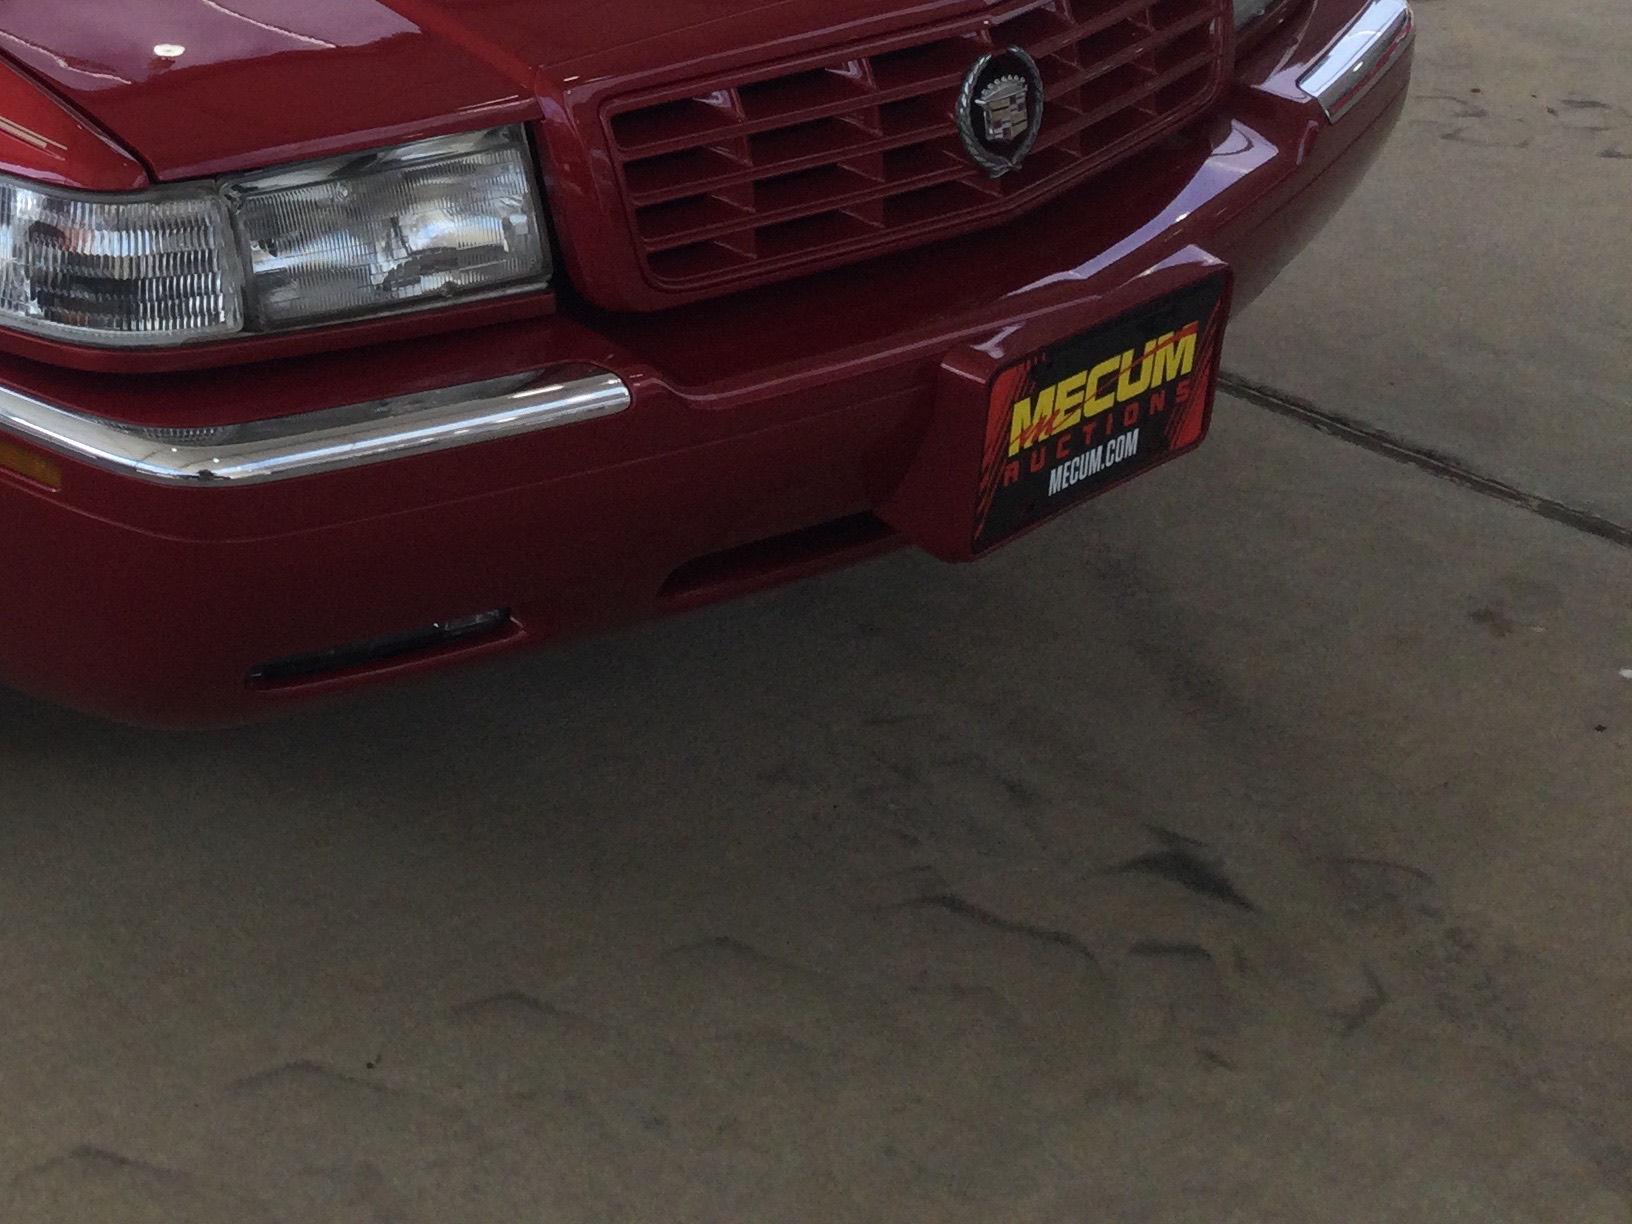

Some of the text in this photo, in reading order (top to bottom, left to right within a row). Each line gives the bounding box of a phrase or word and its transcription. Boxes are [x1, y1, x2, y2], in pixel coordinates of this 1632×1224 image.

[1003, 378, 1192, 487] AUCTIONS
[1008, 320, 1199, 458] MECUM
[1048, 428, 1140, 497] MECUM.COM
